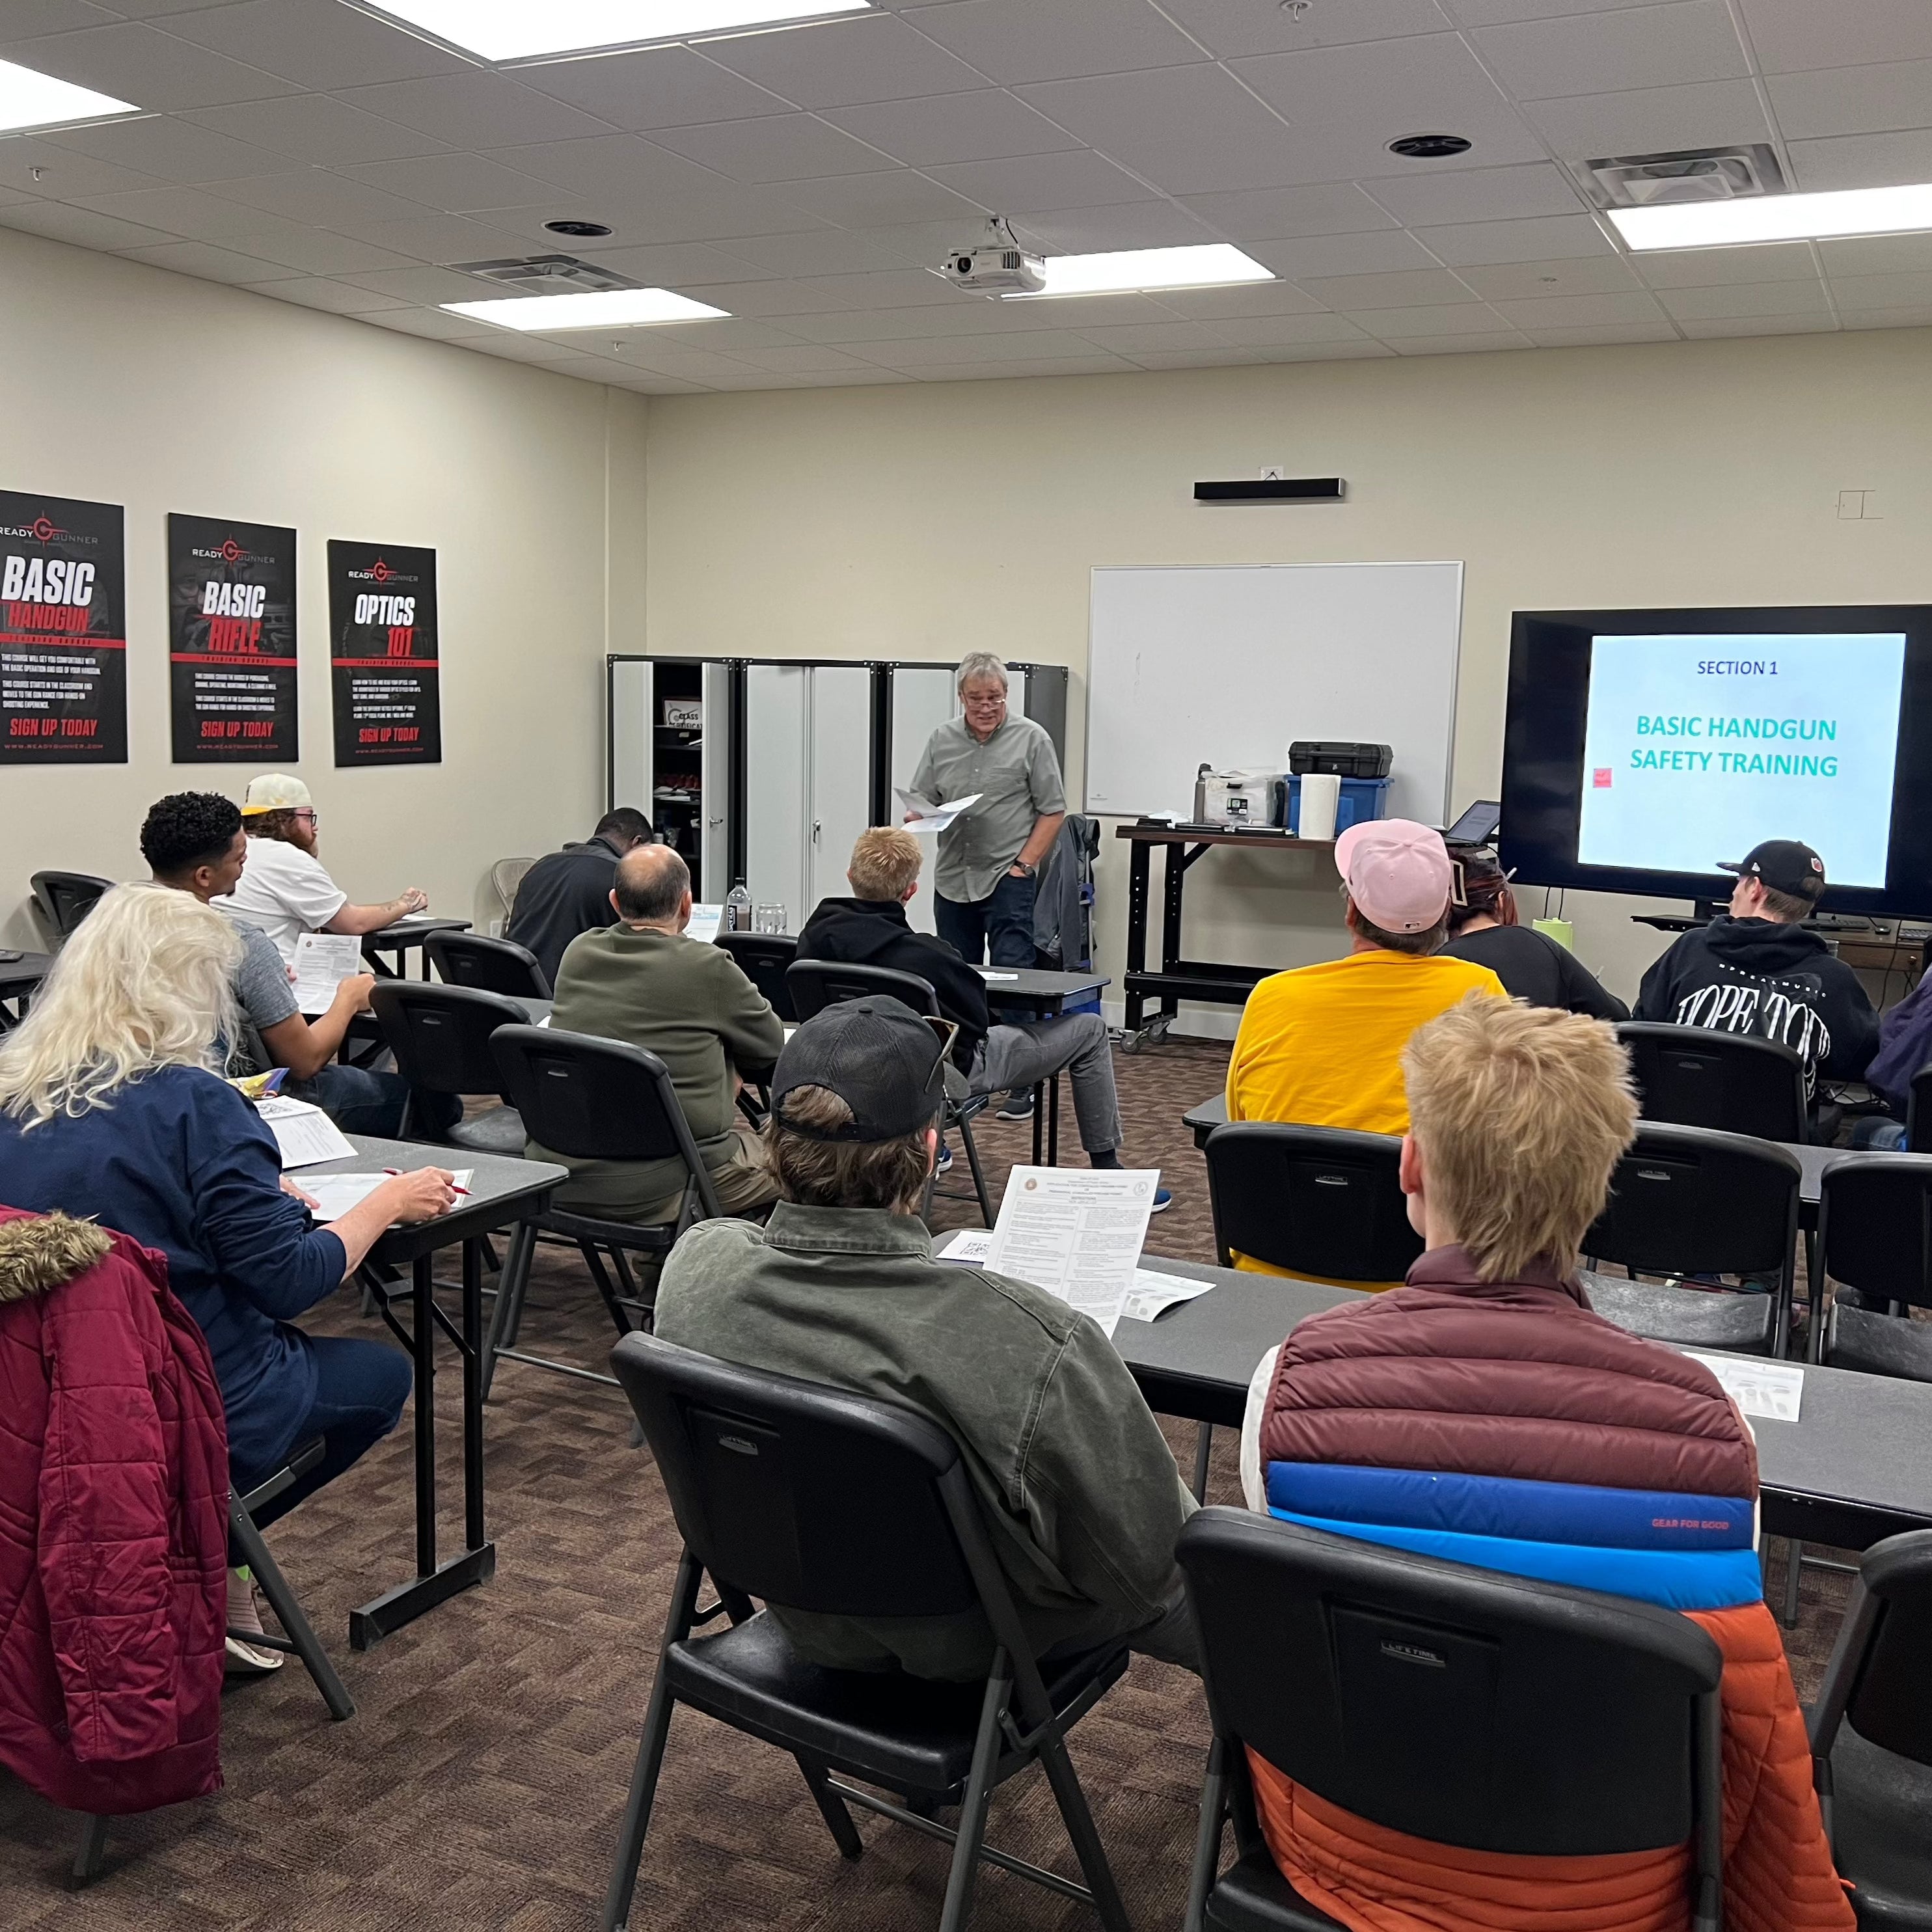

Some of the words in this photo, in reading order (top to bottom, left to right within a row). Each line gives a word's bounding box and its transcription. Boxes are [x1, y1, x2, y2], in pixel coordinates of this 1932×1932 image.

[53, 534, 98, 545] GUNNER
[193, 549, 222, 558] READY
[238, 554, 275, 564] GUNNER
[1, 556, 95, 606] BASIC
[348, 571, 374, 580] READY
[202, 581, 266, 618] BASIC
[355, 593, 416, 626] OPTICS
[8, 603, 90, 633] HANDGUN
[208, 618, 262, 653] RIFLE
[387, 627, 413, 657] 101
[1697, 660, 1765, 675] SECTION
[1769, 660, 1778, 675] 1
[10, 718, 39, 736] SIGN
[42, 718, 58, 736] UP
[61, 718, 98, 737] TODAY
[201, 721, 225, 737] SIGN
[226, 721, 241, 737] UP
[243, 721, 274, 737] TODAY
[359, 728, 379, 742] SIGN
[380, 728, 392, 742] UP
[393, 727, 420, 742] TODAY
[1637, 716, 1702, 737] BASIC
[1708, 718, 1836, 741] HANDGUN
[1630, 749, 1713, 772] SAFETY
[1719, 752, 1838, 777] TRAINING
[1652, 1518, 1679, 1528] GEAR
[1680, 1519, 1700, 1529] FOR
[1702, 1520, 1729, 1530] GOOD
